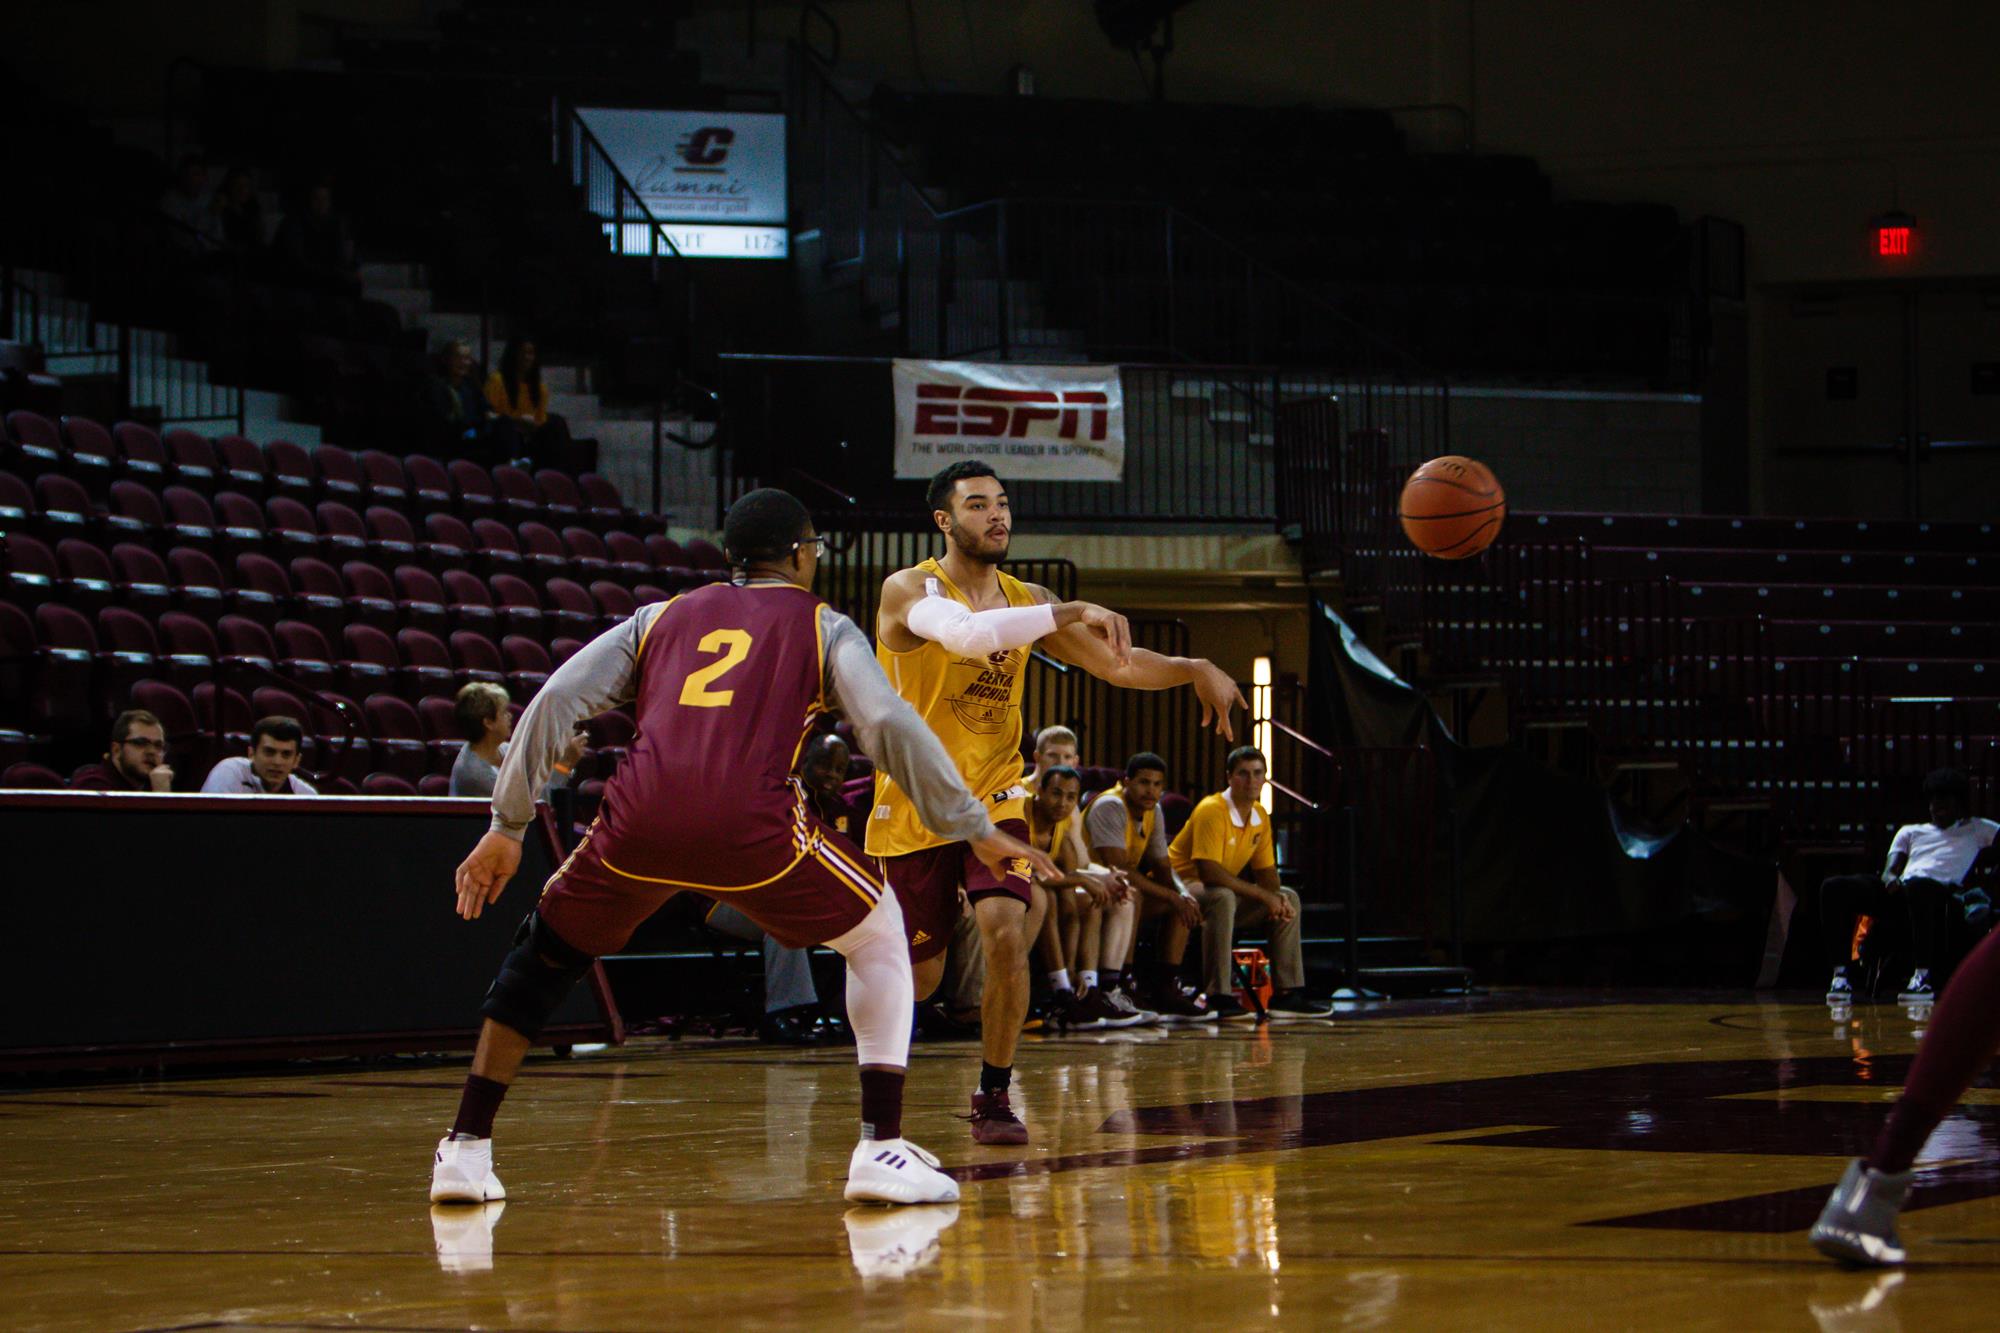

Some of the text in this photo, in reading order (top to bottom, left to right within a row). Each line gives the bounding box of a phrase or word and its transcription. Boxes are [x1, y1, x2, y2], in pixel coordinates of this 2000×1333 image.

[1880, 227, 1909, 255] EXIT
[914, 384, 1107, 441] ESPN
[912, 442, 1105, 457] THE WORLDWIDE LEADER IN SPORTS
[679, 629, 752, 707] 2
